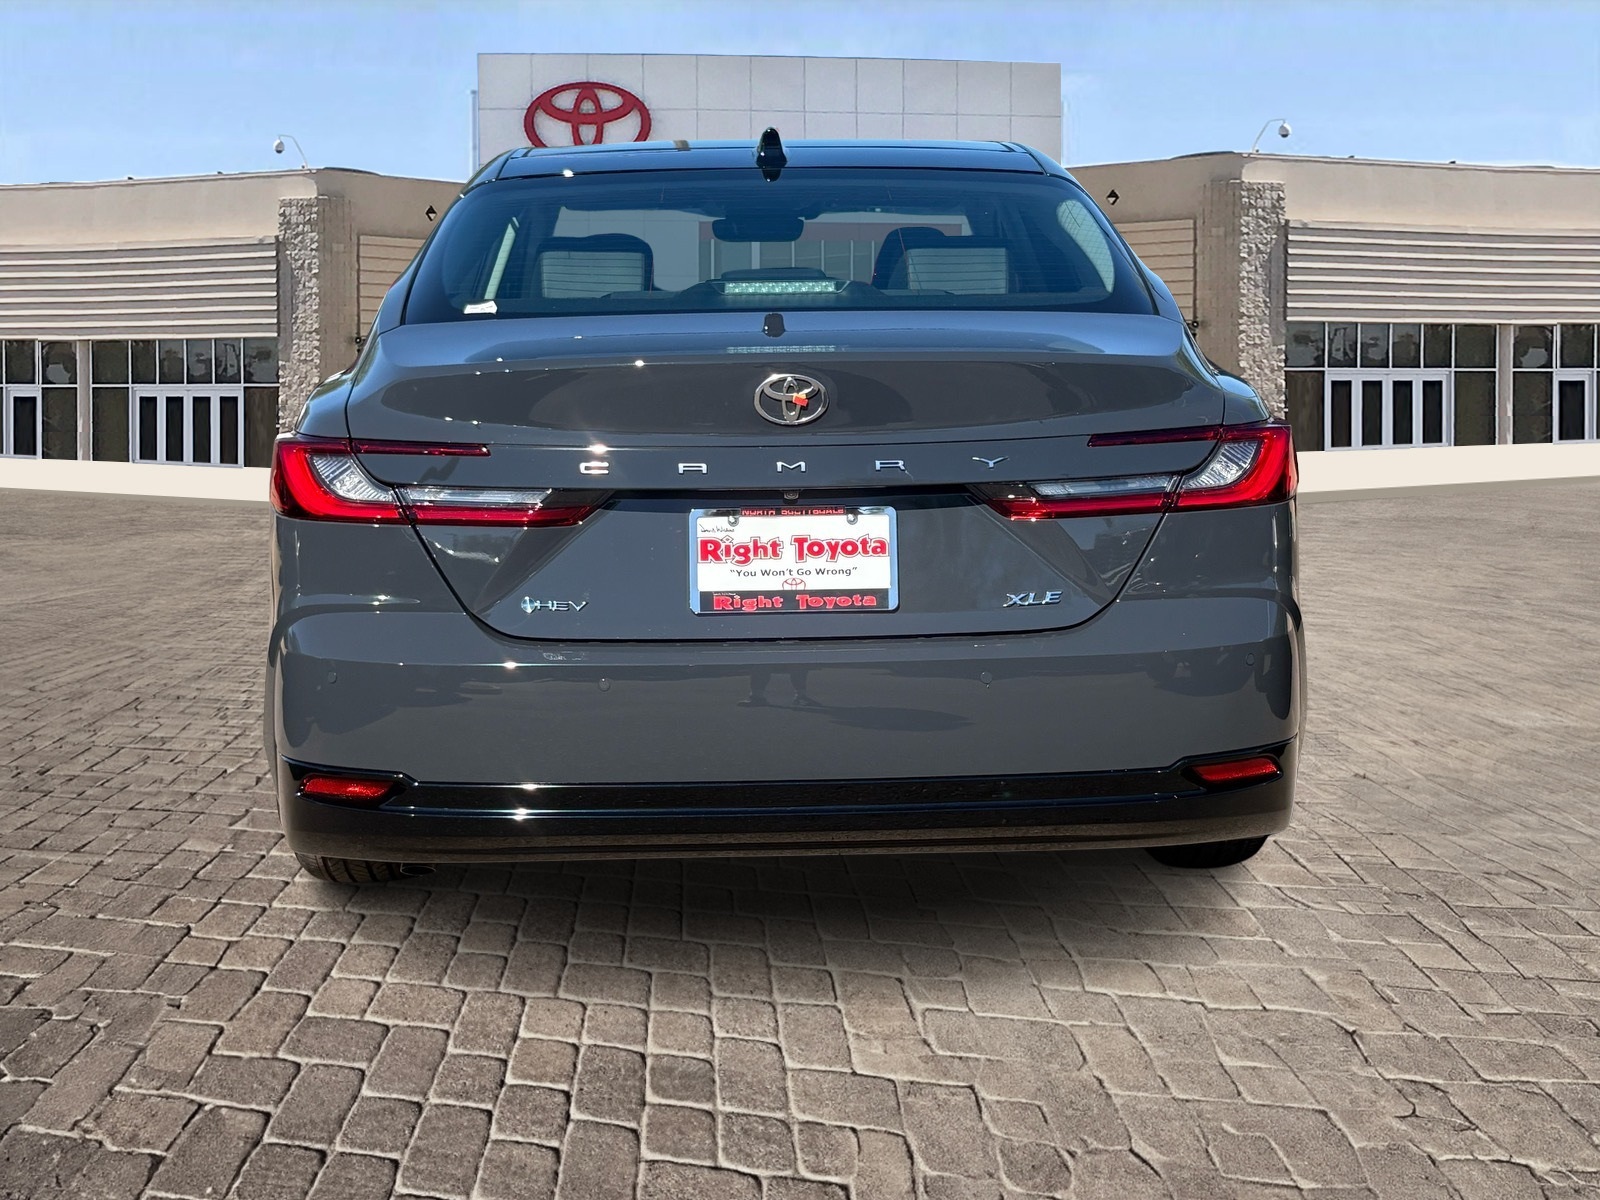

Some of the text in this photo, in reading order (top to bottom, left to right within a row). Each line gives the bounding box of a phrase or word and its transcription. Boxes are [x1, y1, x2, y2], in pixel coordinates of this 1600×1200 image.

[579, 456, 1009, 475] CAMRY
[699, 535, 889, 566] Right Toyota
[796, 567, 812, 576] Go
[534, 600, 587, 612] HEV
[713, 594, 877, 611] Right Toyota
[1002, 591, 1063, 607] XLE
